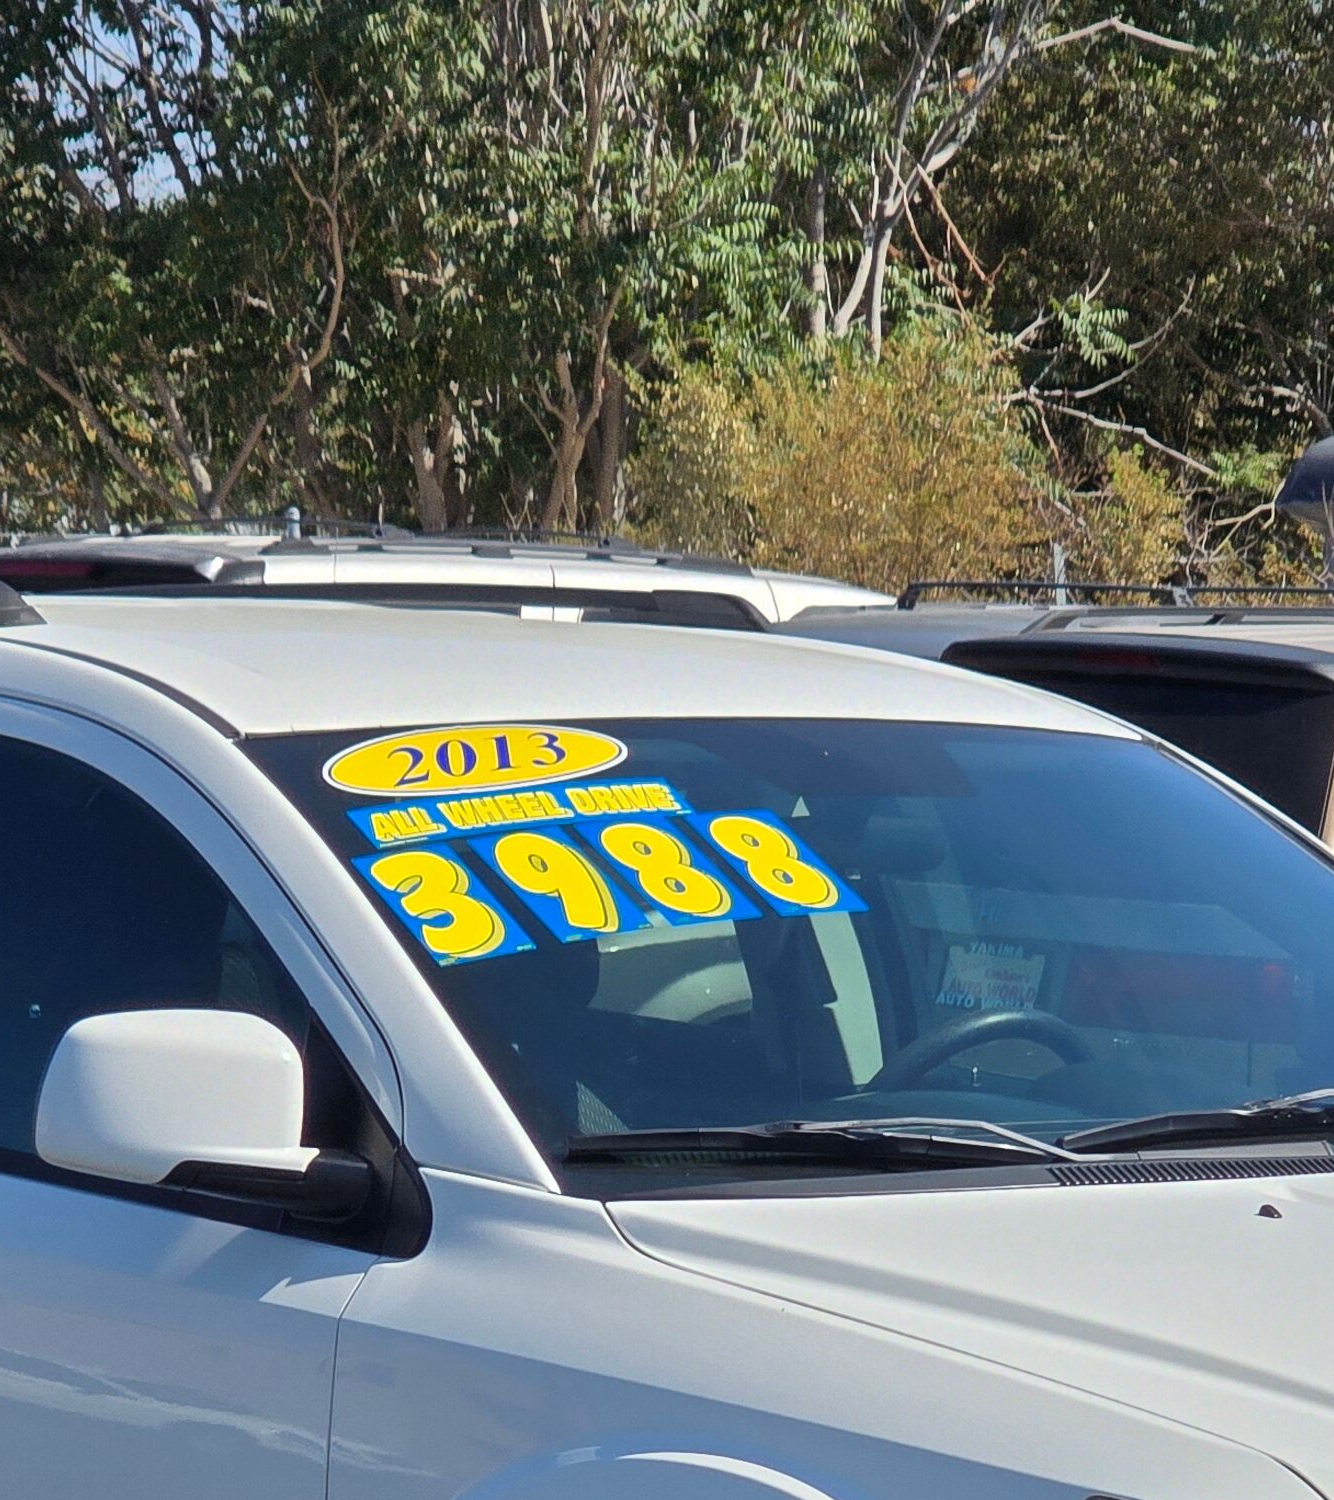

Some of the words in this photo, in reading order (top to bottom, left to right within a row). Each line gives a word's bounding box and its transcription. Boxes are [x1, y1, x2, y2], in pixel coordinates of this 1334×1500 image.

[386, 731, 567, 787] 2013
[370, 807, 446, 842] ALL
[437, 789, 574, 829] WHEEL
[565, 783, 681, 814] DRIVE
[370, 815, 839, 958] 3988
